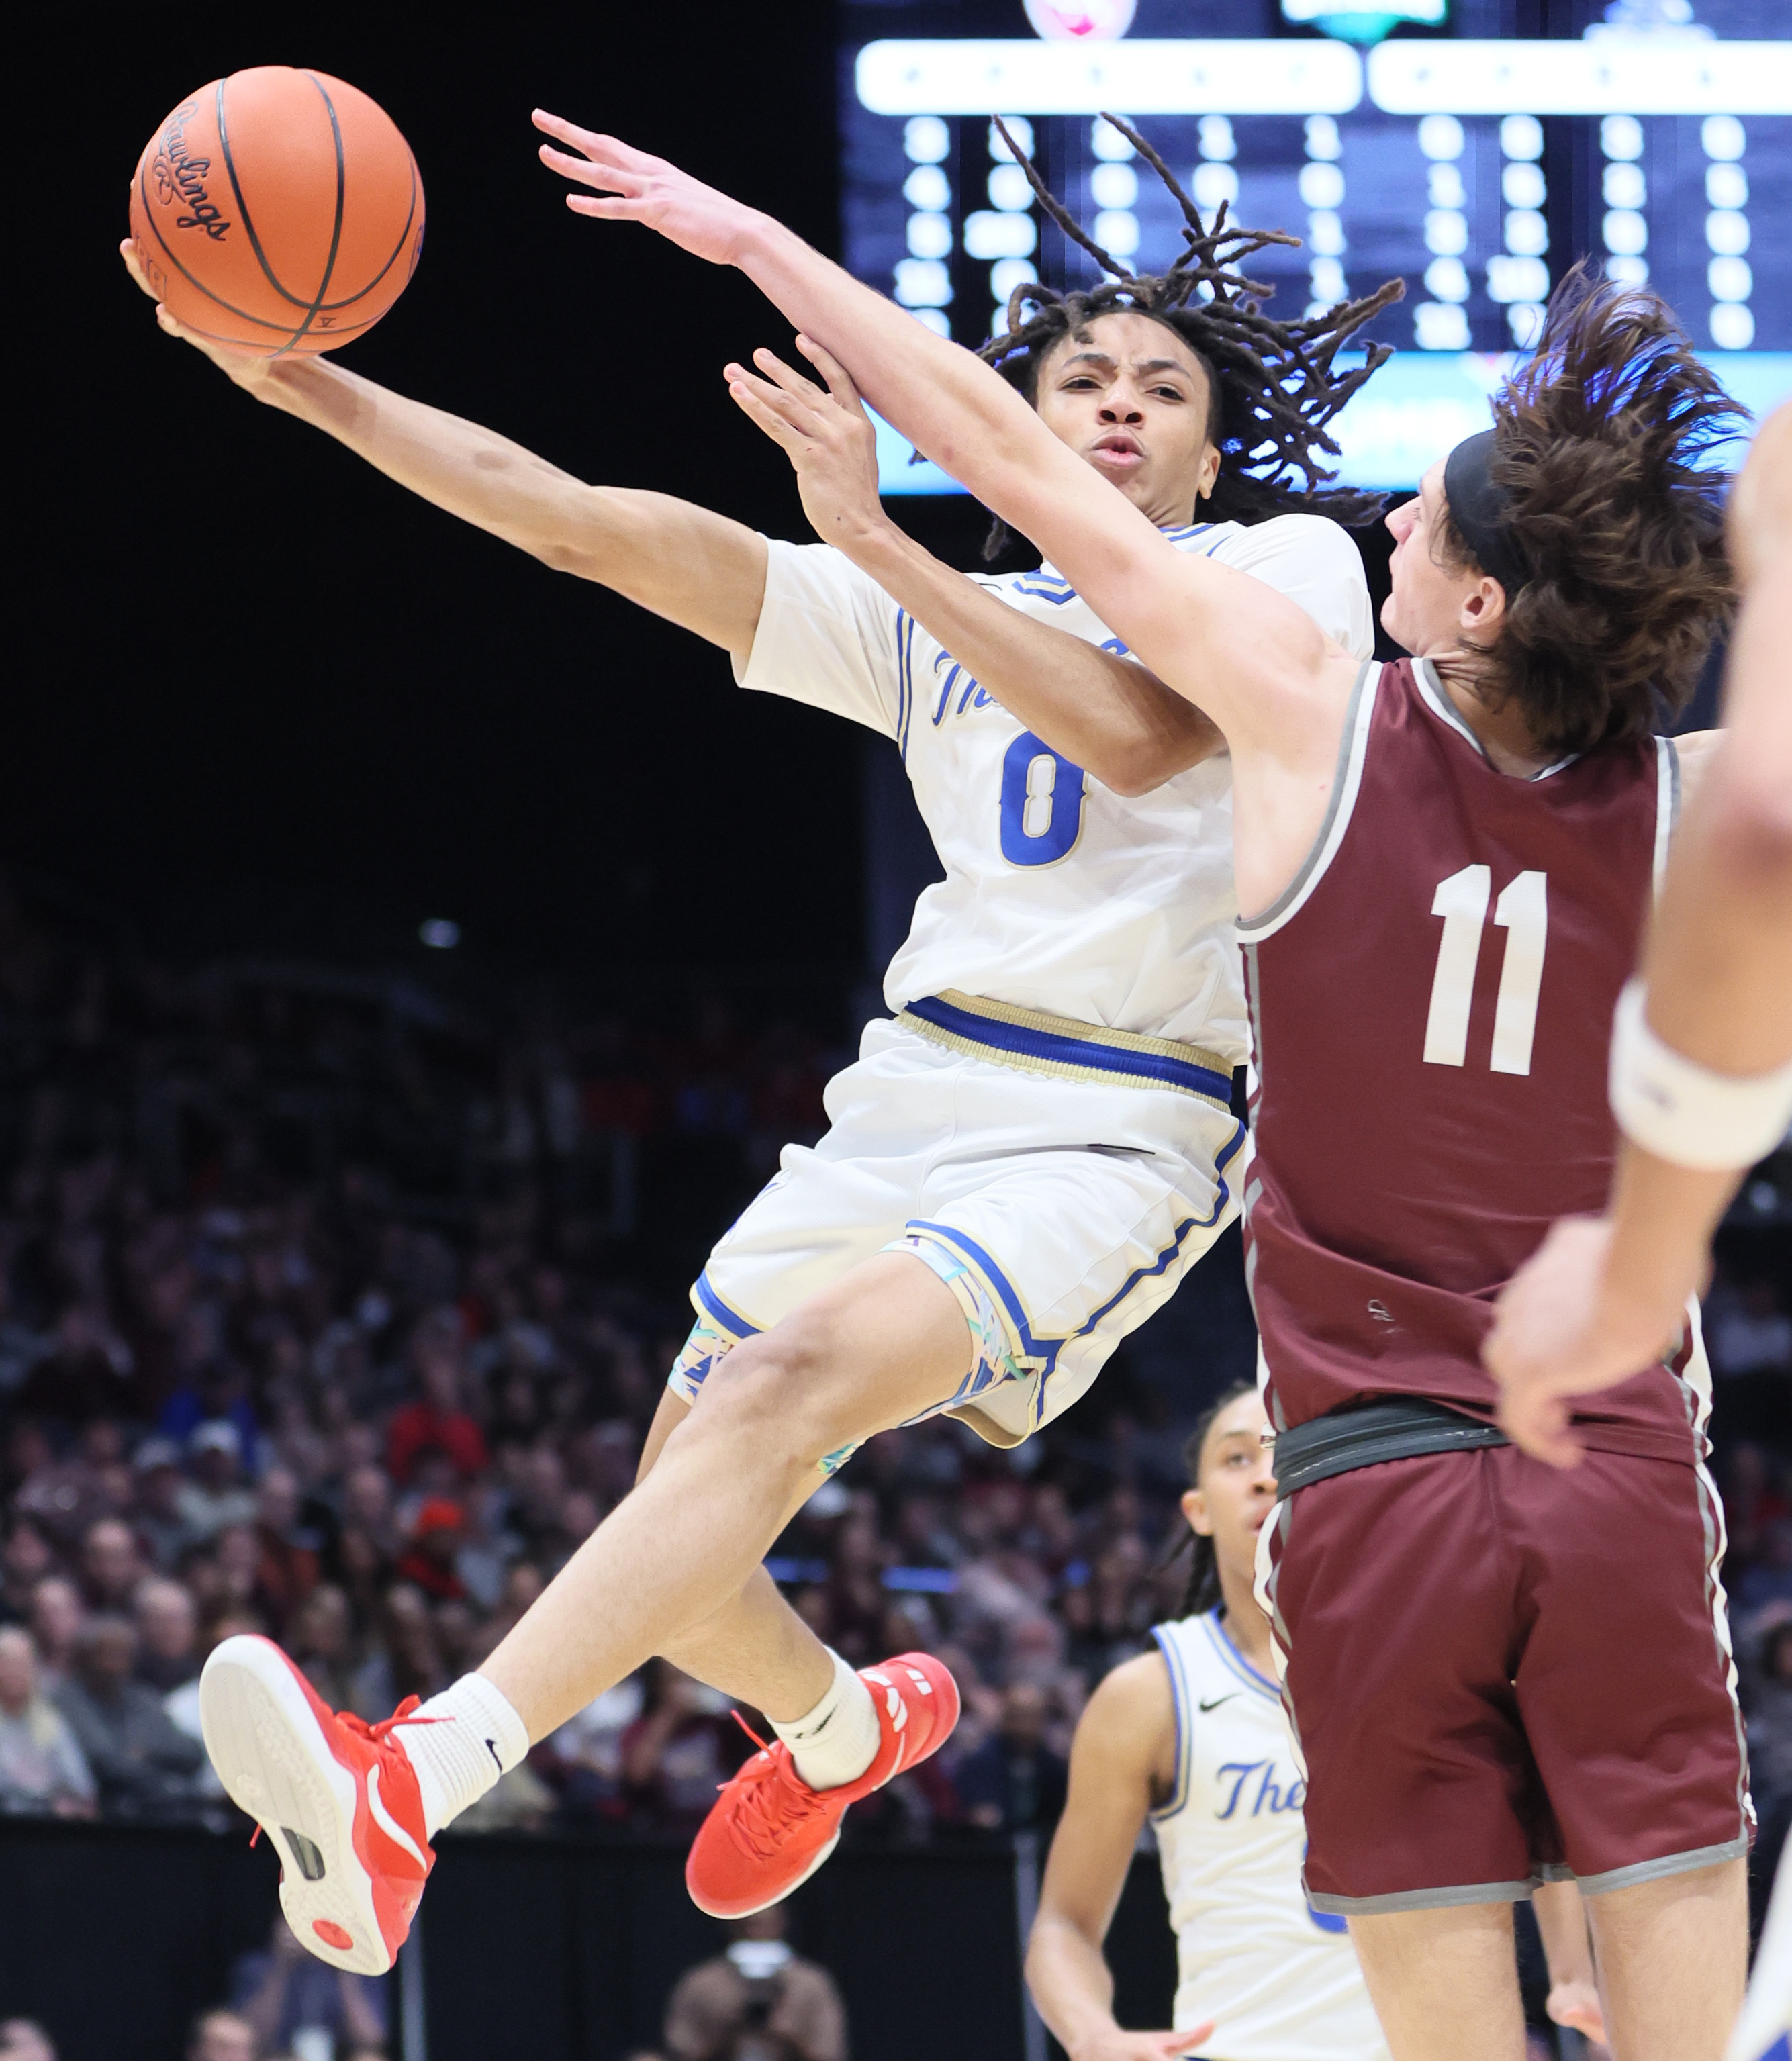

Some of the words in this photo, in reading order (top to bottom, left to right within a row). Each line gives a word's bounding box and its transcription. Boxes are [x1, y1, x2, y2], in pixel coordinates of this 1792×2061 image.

[159, 101, 231, 241] Rawlings
[998, 728, 1090, 871] 0
[1422, 862, 1548, 1076] 11
[1215, 1758, 1307, 1821] The
